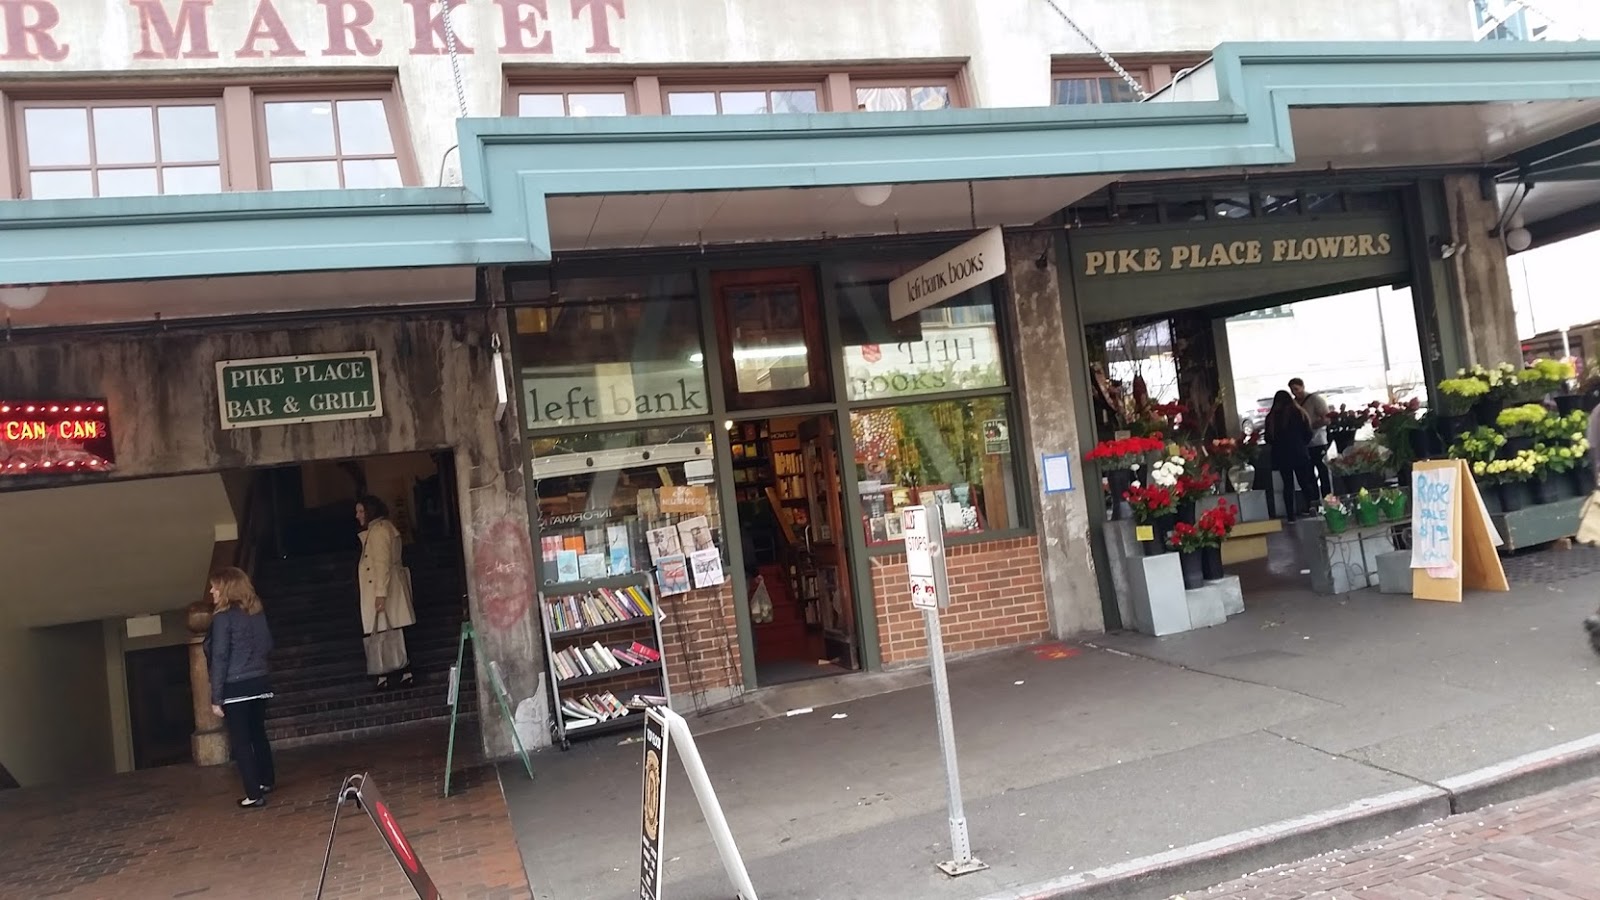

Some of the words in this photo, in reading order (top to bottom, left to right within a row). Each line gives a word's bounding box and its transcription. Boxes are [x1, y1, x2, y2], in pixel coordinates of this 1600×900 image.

[133, 0, 626, 60] MARKET
[1085, 247, 1162, 276] PIKE
[1170, 239, 1262, 270] PLACE
[1272, 232, 1392, 262] FLOWERS
[921, 272, 947, 297] bank
[948, 252, 984, 284] books
[230, 366, 285, 388] PIKE
[293, 360, 366, 384] PLACE
[850, 371, 946, 396] OOKS
[226, 399, 272, 419] BAR
[282, 395, 301, 414] &
[309, 389, 377, 412] GRILL
[529, 386, 597, 423] left
[609, 378, 703, 416] bank
[6, 420, 46, 440] CAN
[59, 420, 97, 439] CAN
[1417, 474, 1450, 504] Rose
[1420, 508, 1448, 521] SALE
